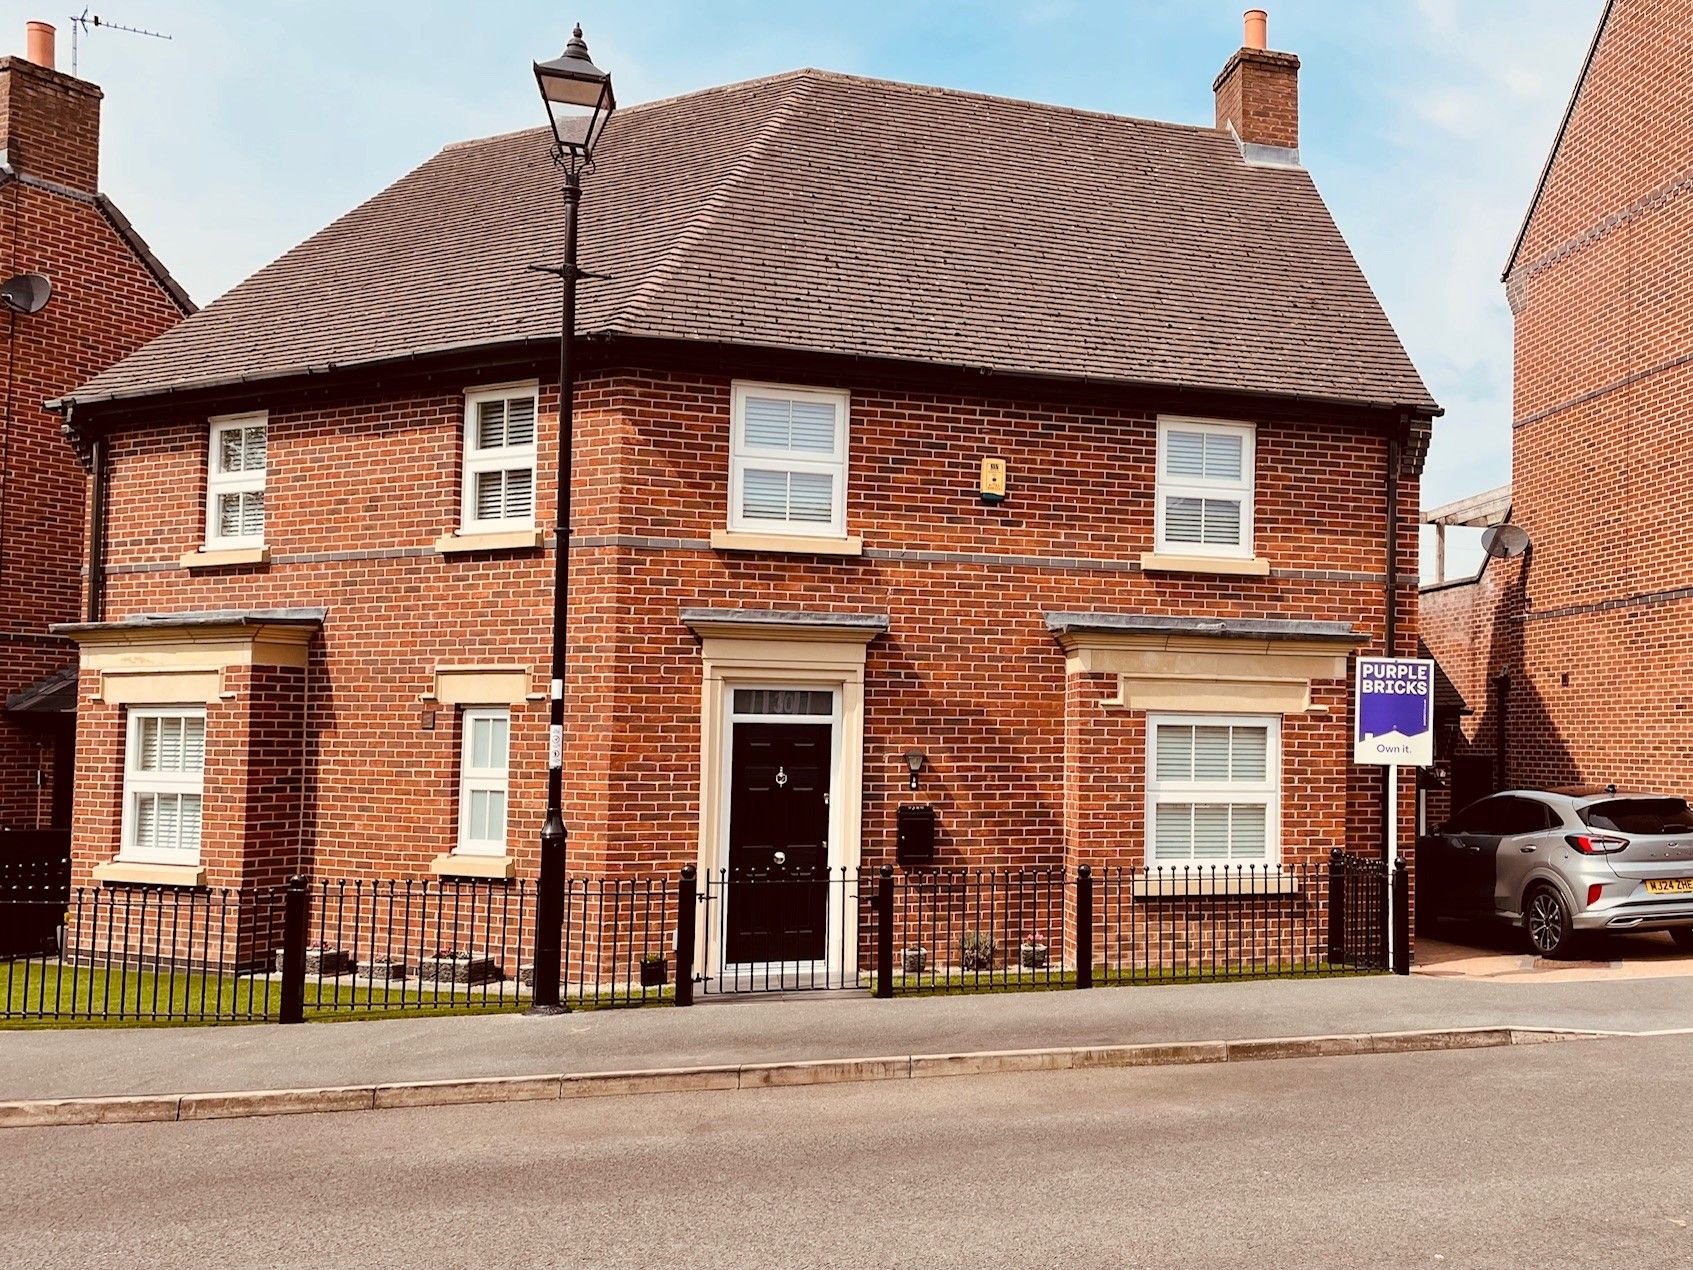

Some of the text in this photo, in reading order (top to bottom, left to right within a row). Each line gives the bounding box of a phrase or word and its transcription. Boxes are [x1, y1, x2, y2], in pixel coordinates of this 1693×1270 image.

[1362, 664, 1428, 680] PURPLE
[1362, 679, 1428, 695] BRICKS
[1376, 744, 1412, 754] Own it.
